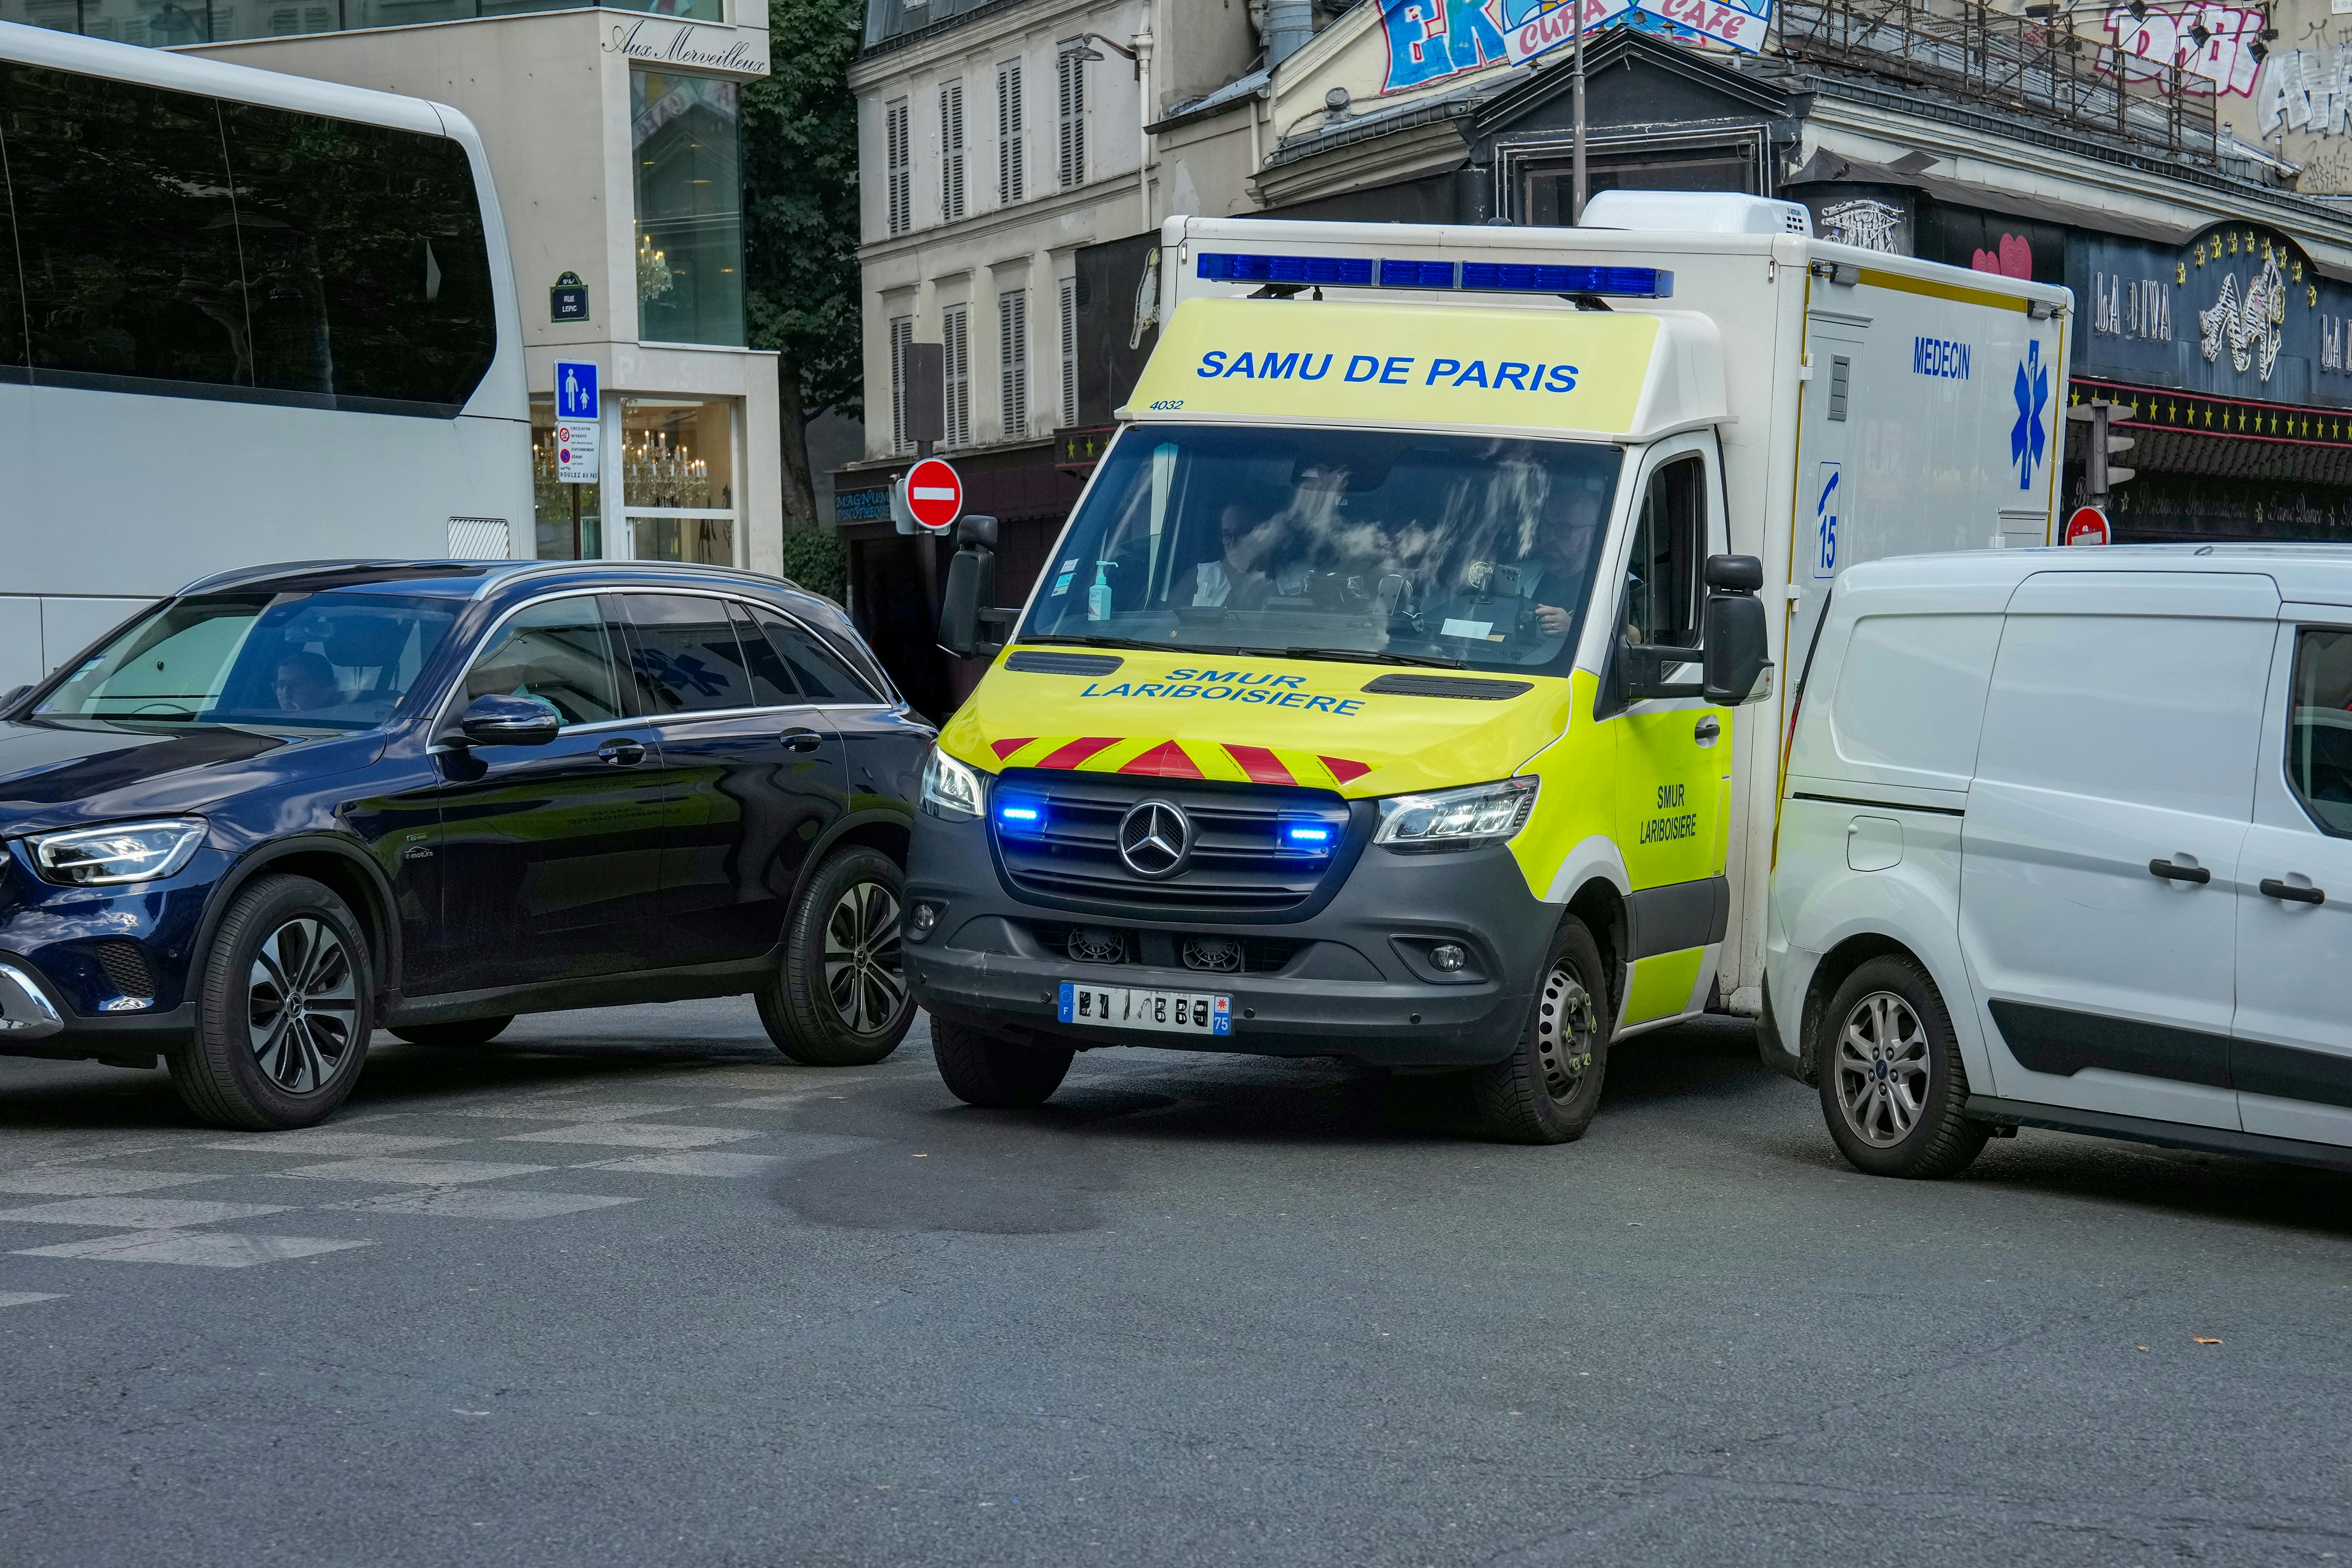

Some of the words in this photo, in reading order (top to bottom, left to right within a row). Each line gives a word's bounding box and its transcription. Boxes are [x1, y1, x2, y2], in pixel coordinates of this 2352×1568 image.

[1520, 0, 1607, 54] CUBA
[602, 20, 652, 57] Aux
[654, 26, 765, 73] Merveilleux
[2095, 272, 2121, 335] LA
[1197, 350, 1334, 381] SAMU
[1344, 354, 1416, 384] DE
[1425, 359, 1580, 394] PARIS
[1912, 336, 1971, 381] MEDECIN
[1150, 400, 1184, 411] 4032
[836, 490, 890, 508] MAGNUM
[1819, 514, 1837, 569] 15
[1165, 668, 1307, 688] SMUR
[1080, 683, 1366, 716] LARIBOISIERE
[1657, 784, 1685, 809] SMUR
[1640, 813, 1697, 844] LARIBOISIERE
[1215, 1017, 1228, 1030] 75
